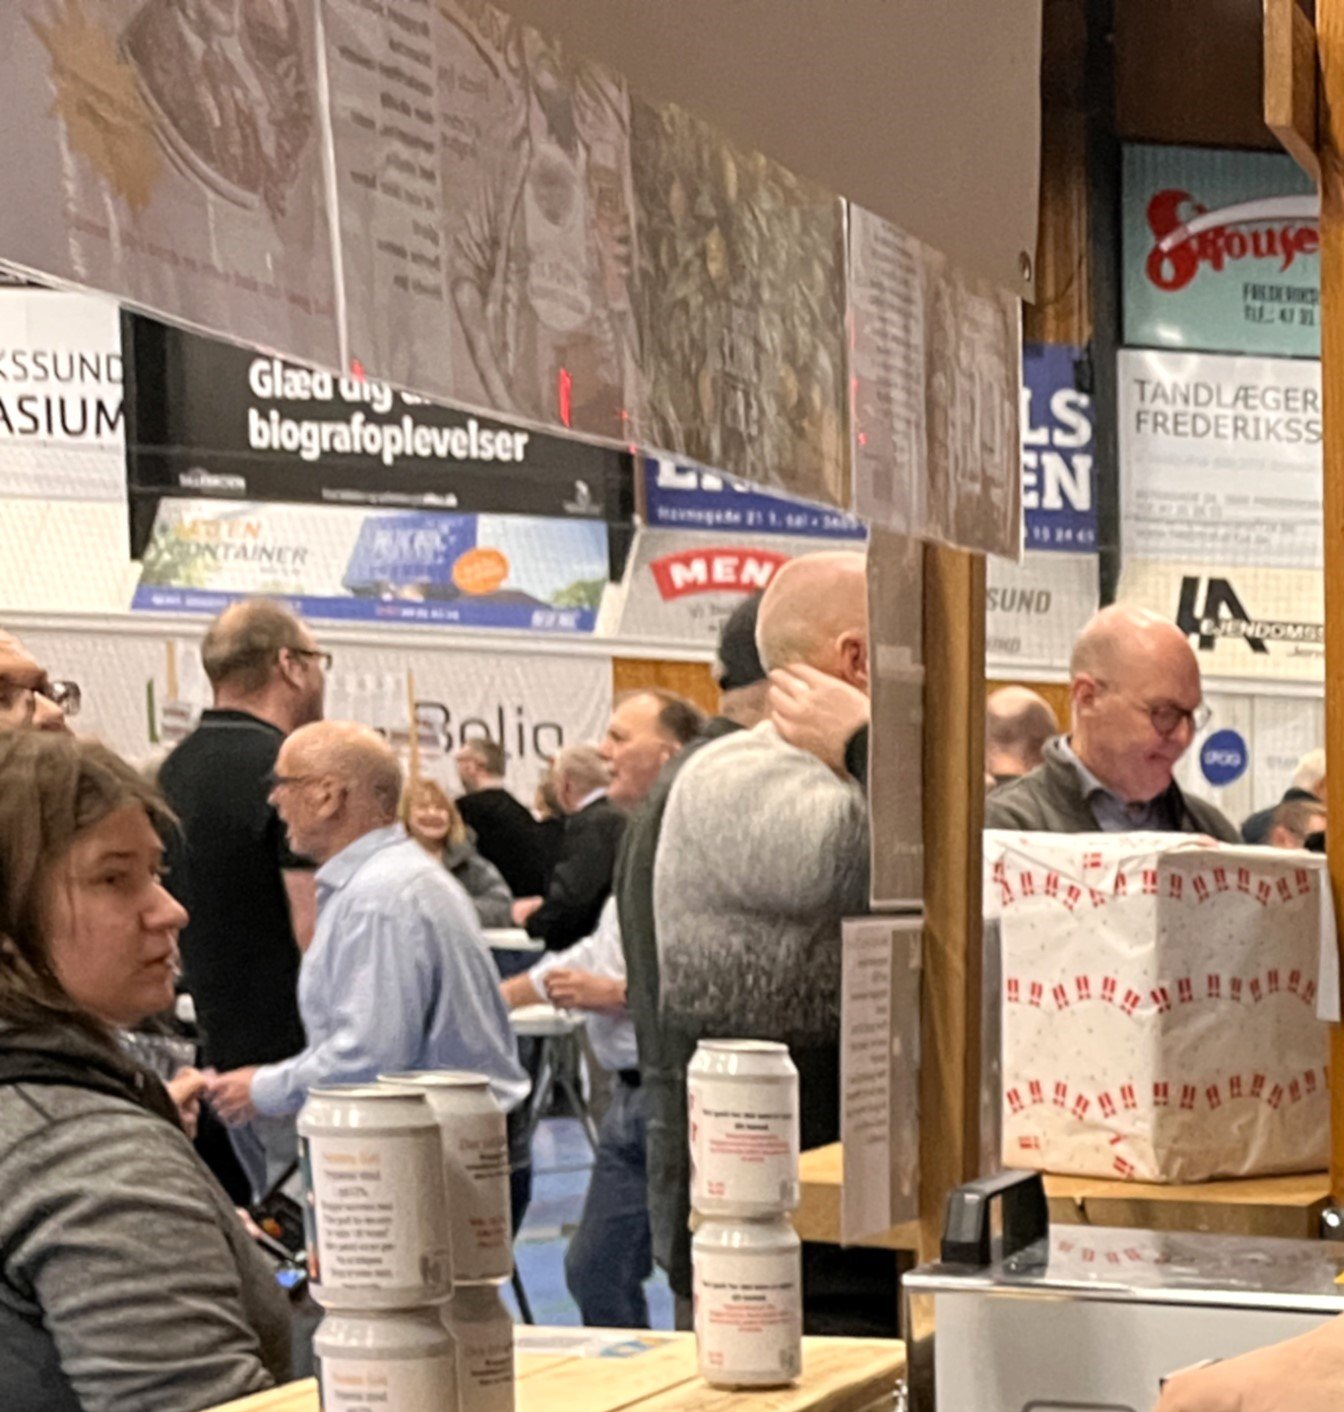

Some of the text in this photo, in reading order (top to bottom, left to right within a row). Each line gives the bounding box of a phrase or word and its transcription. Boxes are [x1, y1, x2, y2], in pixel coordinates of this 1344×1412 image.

[249, 358, 333, 401] Glæd
[1134, 378, 1320, 414] TANDLÆGER
[248, 407, 530, 466] biografoplevelser
